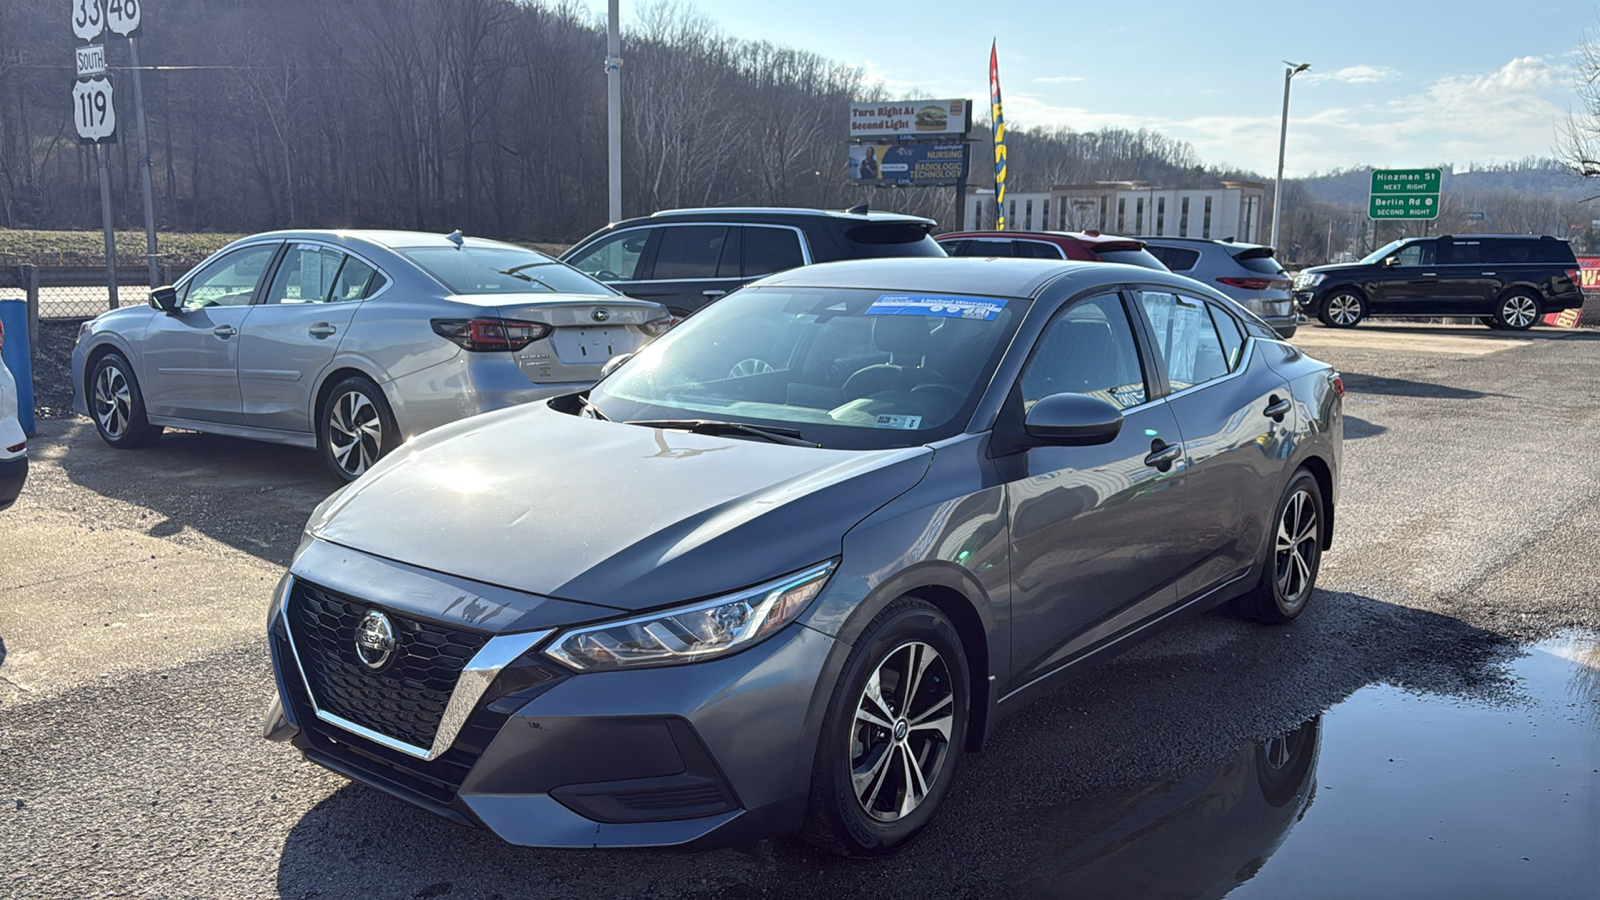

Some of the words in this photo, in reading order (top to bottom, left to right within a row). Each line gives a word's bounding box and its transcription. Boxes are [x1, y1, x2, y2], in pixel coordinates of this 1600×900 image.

[76, 0, 100, 28] 33
[78, 49, 104, 71] SOUTH
[80, 90, 107, 128] 119
[852, 108, 875, 117] Turn
[877, 106, 903, 118] Right
[904, 106, 915, 116] At
[852, 120, 884, 130] Second
[885, 119, 910, 131] Light
[927, 151, 963, 159] NURSING
[915, 162, 962, 171] RADIOLOGIC
[910, 170, 962, 179] TECHNOLOGY
[1377, 173, 1420, 181] Hinzman
[1424, 172, 1436, 180] St
[1375, 198, 1404, 206] Berlin
[1409, 197, 1421, 206] Rd
[956, 299, 998, 309] Warranty
[357, 631, 389, 648] NISSAN
